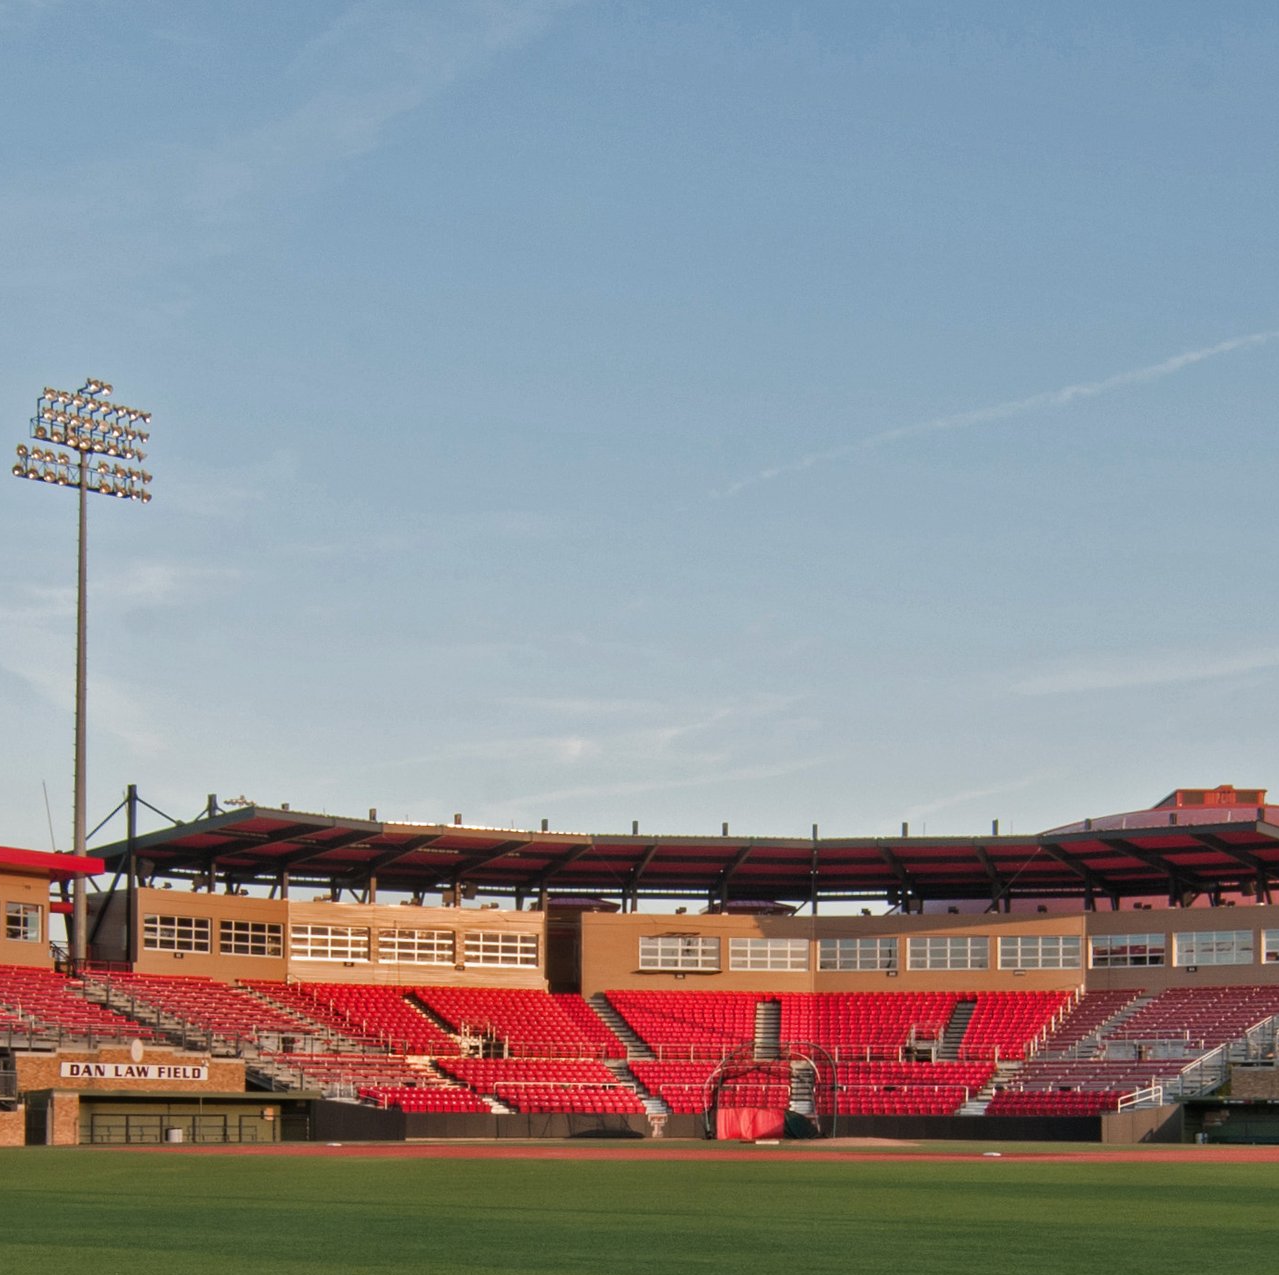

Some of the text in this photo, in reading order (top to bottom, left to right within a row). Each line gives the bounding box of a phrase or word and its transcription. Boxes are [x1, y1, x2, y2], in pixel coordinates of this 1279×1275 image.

[70, 1064, 201, 1079] DAN LAW FIELD
